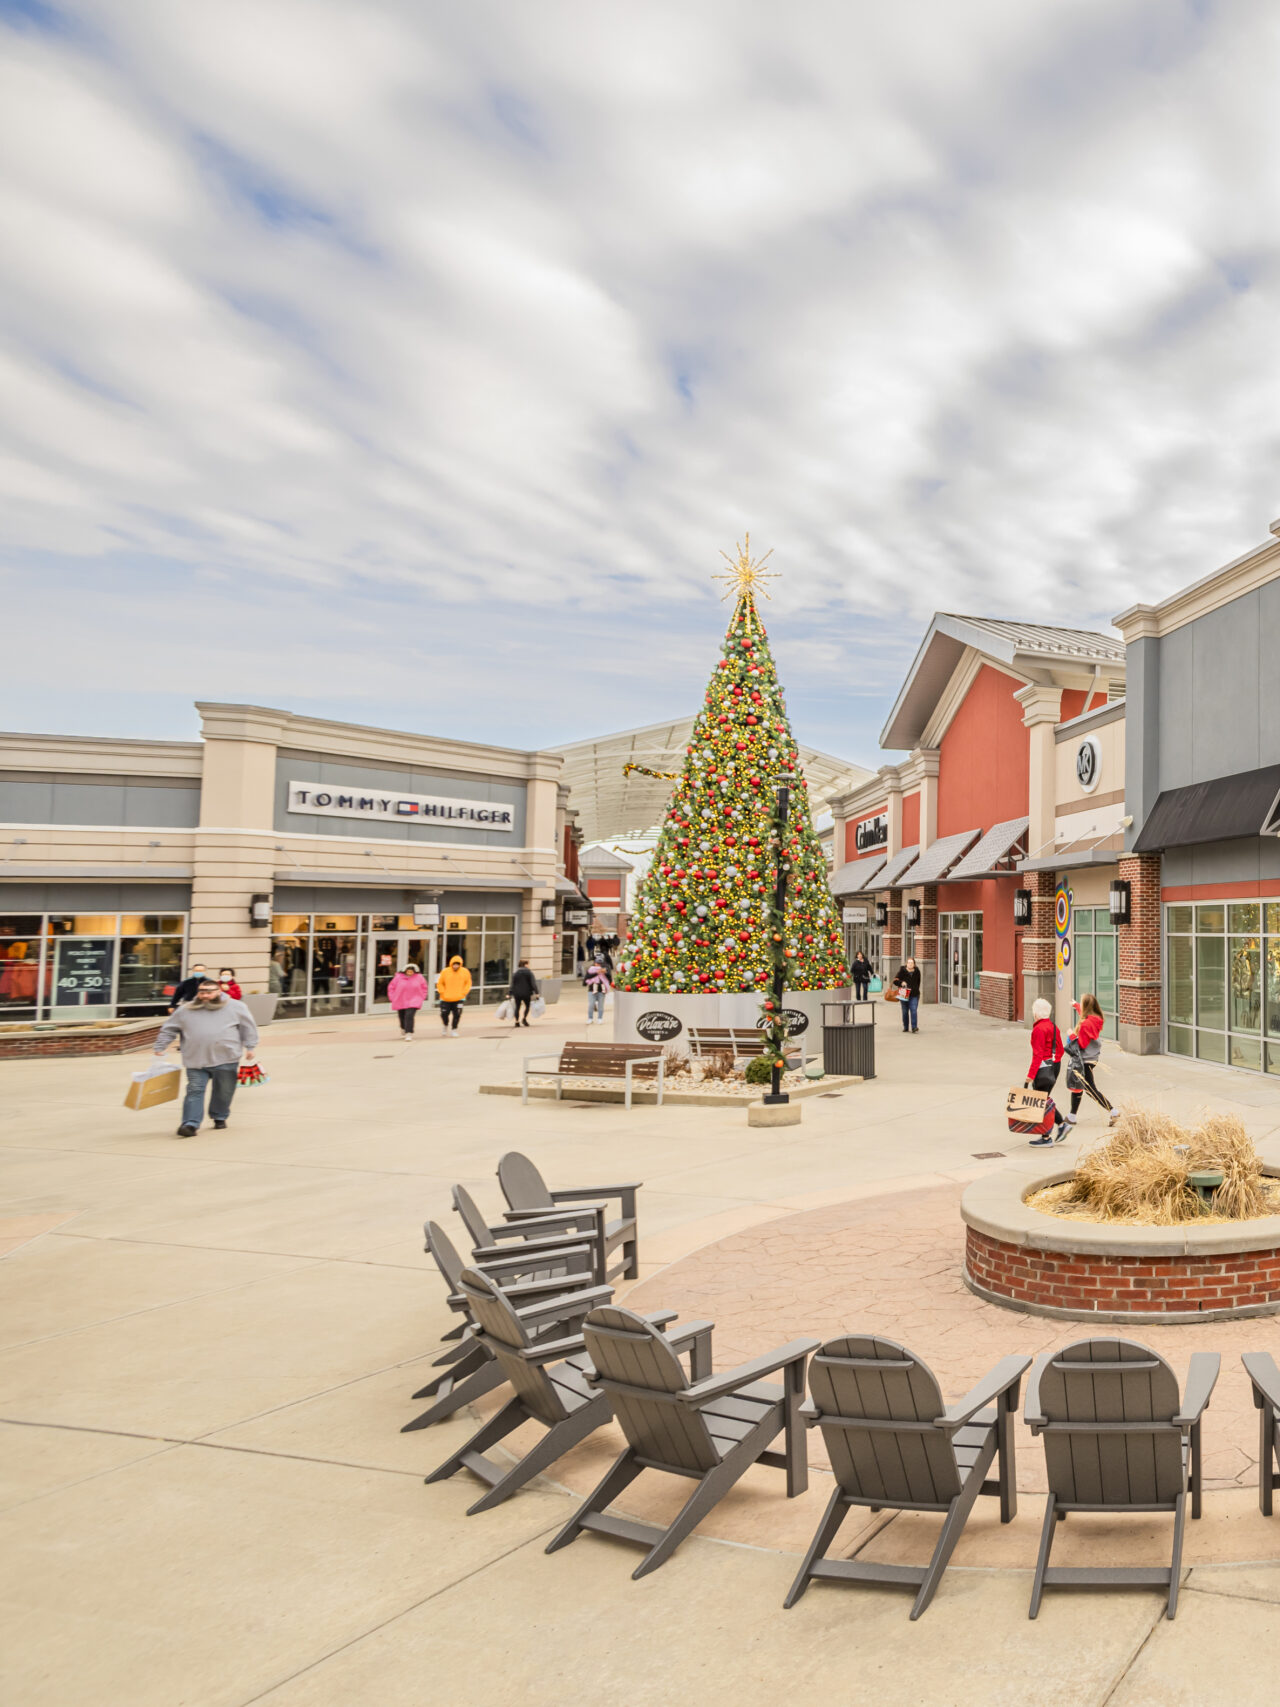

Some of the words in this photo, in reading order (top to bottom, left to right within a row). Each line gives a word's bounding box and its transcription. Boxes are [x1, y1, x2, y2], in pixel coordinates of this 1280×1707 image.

[298, 790, 391, 812] TOMMY
[424, 803, 512, 824] HILFIGER
[1021, 1095, 1047, 1109] NIKE
